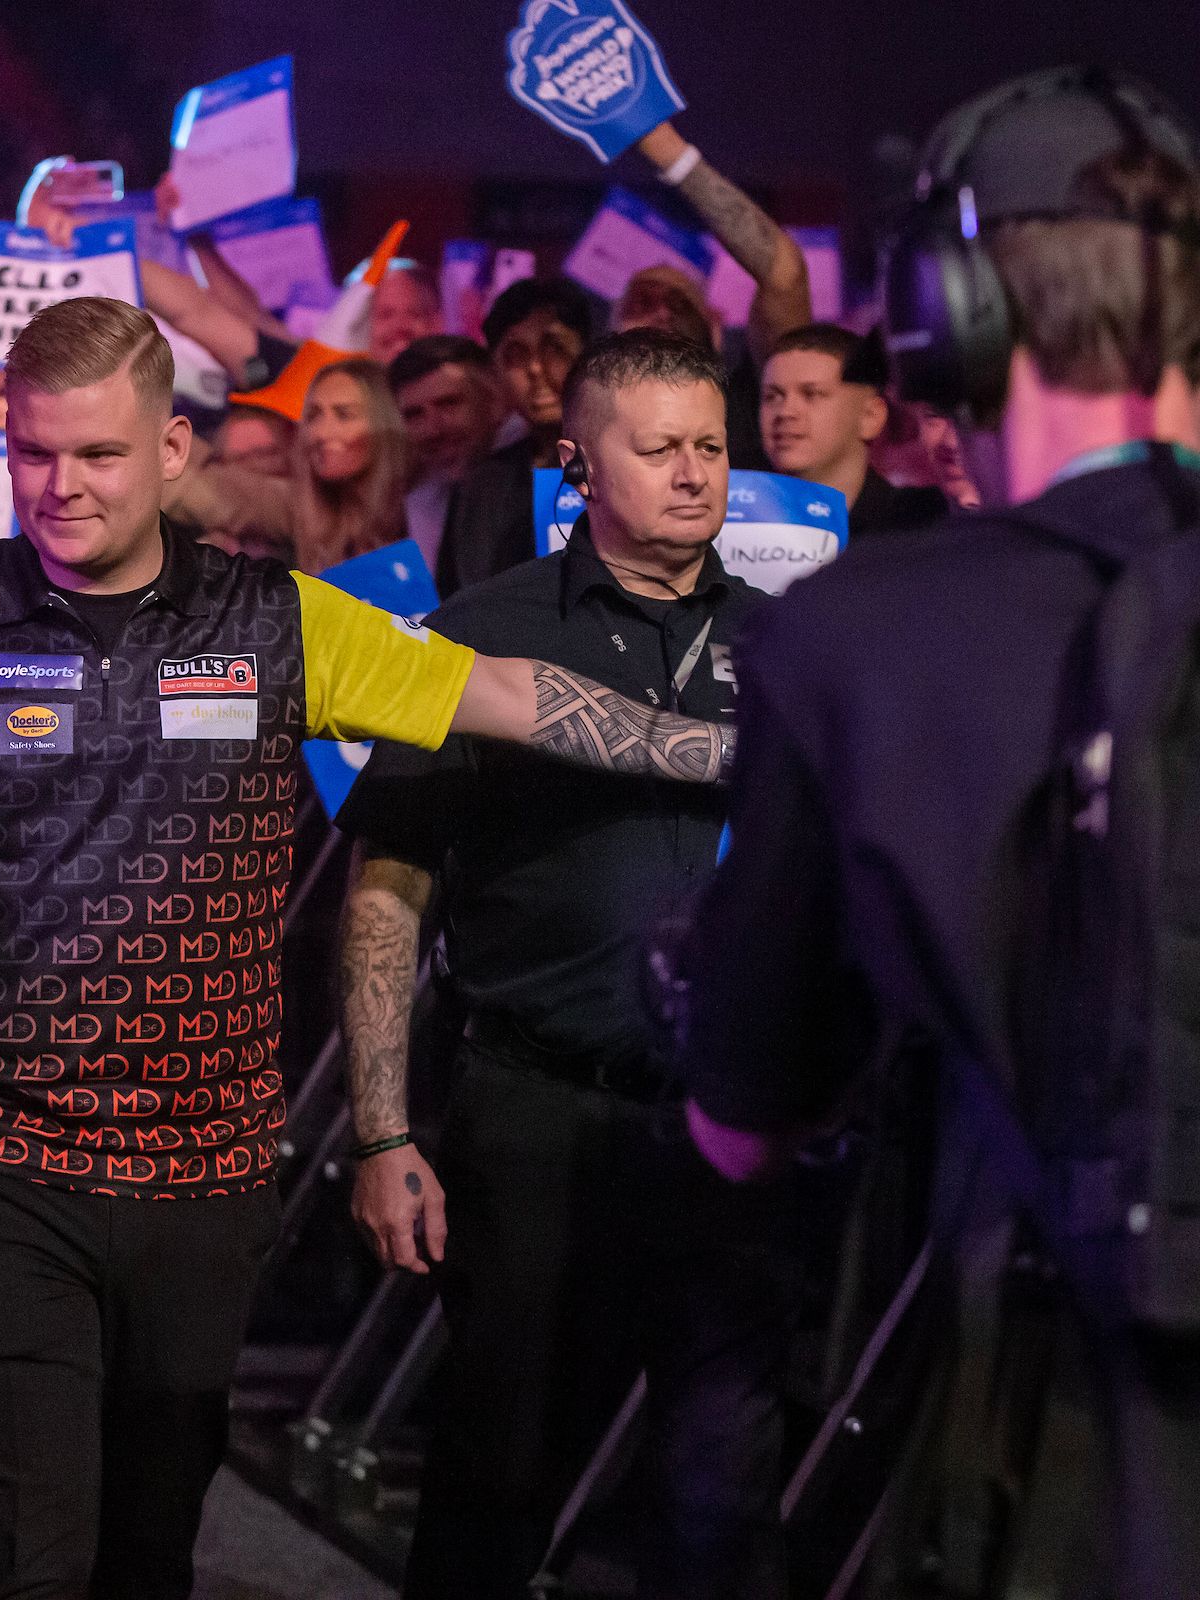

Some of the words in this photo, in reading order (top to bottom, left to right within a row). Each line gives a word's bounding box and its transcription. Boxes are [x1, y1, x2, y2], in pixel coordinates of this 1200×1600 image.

[611, 634, 626, 652] EPS
[163, 659, 224, 677] BULL'S
[646, 687, 660, 705] EPS
[9, 741, 32, 750] Safety
[33, 740, 56, 749] Shoes
[260, 733, 294, 763] MD
[182, 772, 229, 802] MD
[238, 772, 269, 802] MD
[20, 816, 69, 847] MD
[148, 813, 196, 844] MD
[208, 812, 246, 843] MD
[252, 811, 280, 841] MD
[53, 854, 104, 885] MD
[118, 853, 168, 883] MD
[182, 852, 224, 883] MD
[233, 850, 261, 881] MD
[83, 895, 133, 925] MD
[147, 894, 195, 924] MD
[206, 892, 241, 923] MD
[52, 934, 103, 964] MD
[118, 934, 167, 964] MD
[180, 932, 220, 962] MD
[230, 928, 252, 959] MD
[17, 975, 67, 1004] MD
[81, 975, 132, 1004] MD
[146, 973, 193, 1004] MD
[204, 970, 236, 1001] MD
[51, 1013, 102, 1043] MD
[116, 1013, 166, 1043] MD
[178, 1011, 218, 1042] MD
[227, 1005, 252, 1037] MD
[13, 1054, 65, 1081] MD
[78, 1054, 129, 1081] MD
[142, 1053, 190, 1081] MD
[200, 1048, 234, 1079] MD
[239, 1040, 264, 1072] MD
[48, 1089, 99, 1116] MD
[113, 1089, 161, 1116] MD
[171, 1088, 212, 1116] MD
[219, 1080, 245, 1111] MD
[252, 1070, 282, 1100] MD
[75, 1127, 125, 1149] MD
[136, 1126, 183, 1150] MD
[190, 1120, 235, 1147] MD
[41, 1144, 93, 1175] MD
[107, 1154, 156, 1182] MD
[168, 1155, 206, 1183] MD
[216, 1146, 251, 1179] MD
